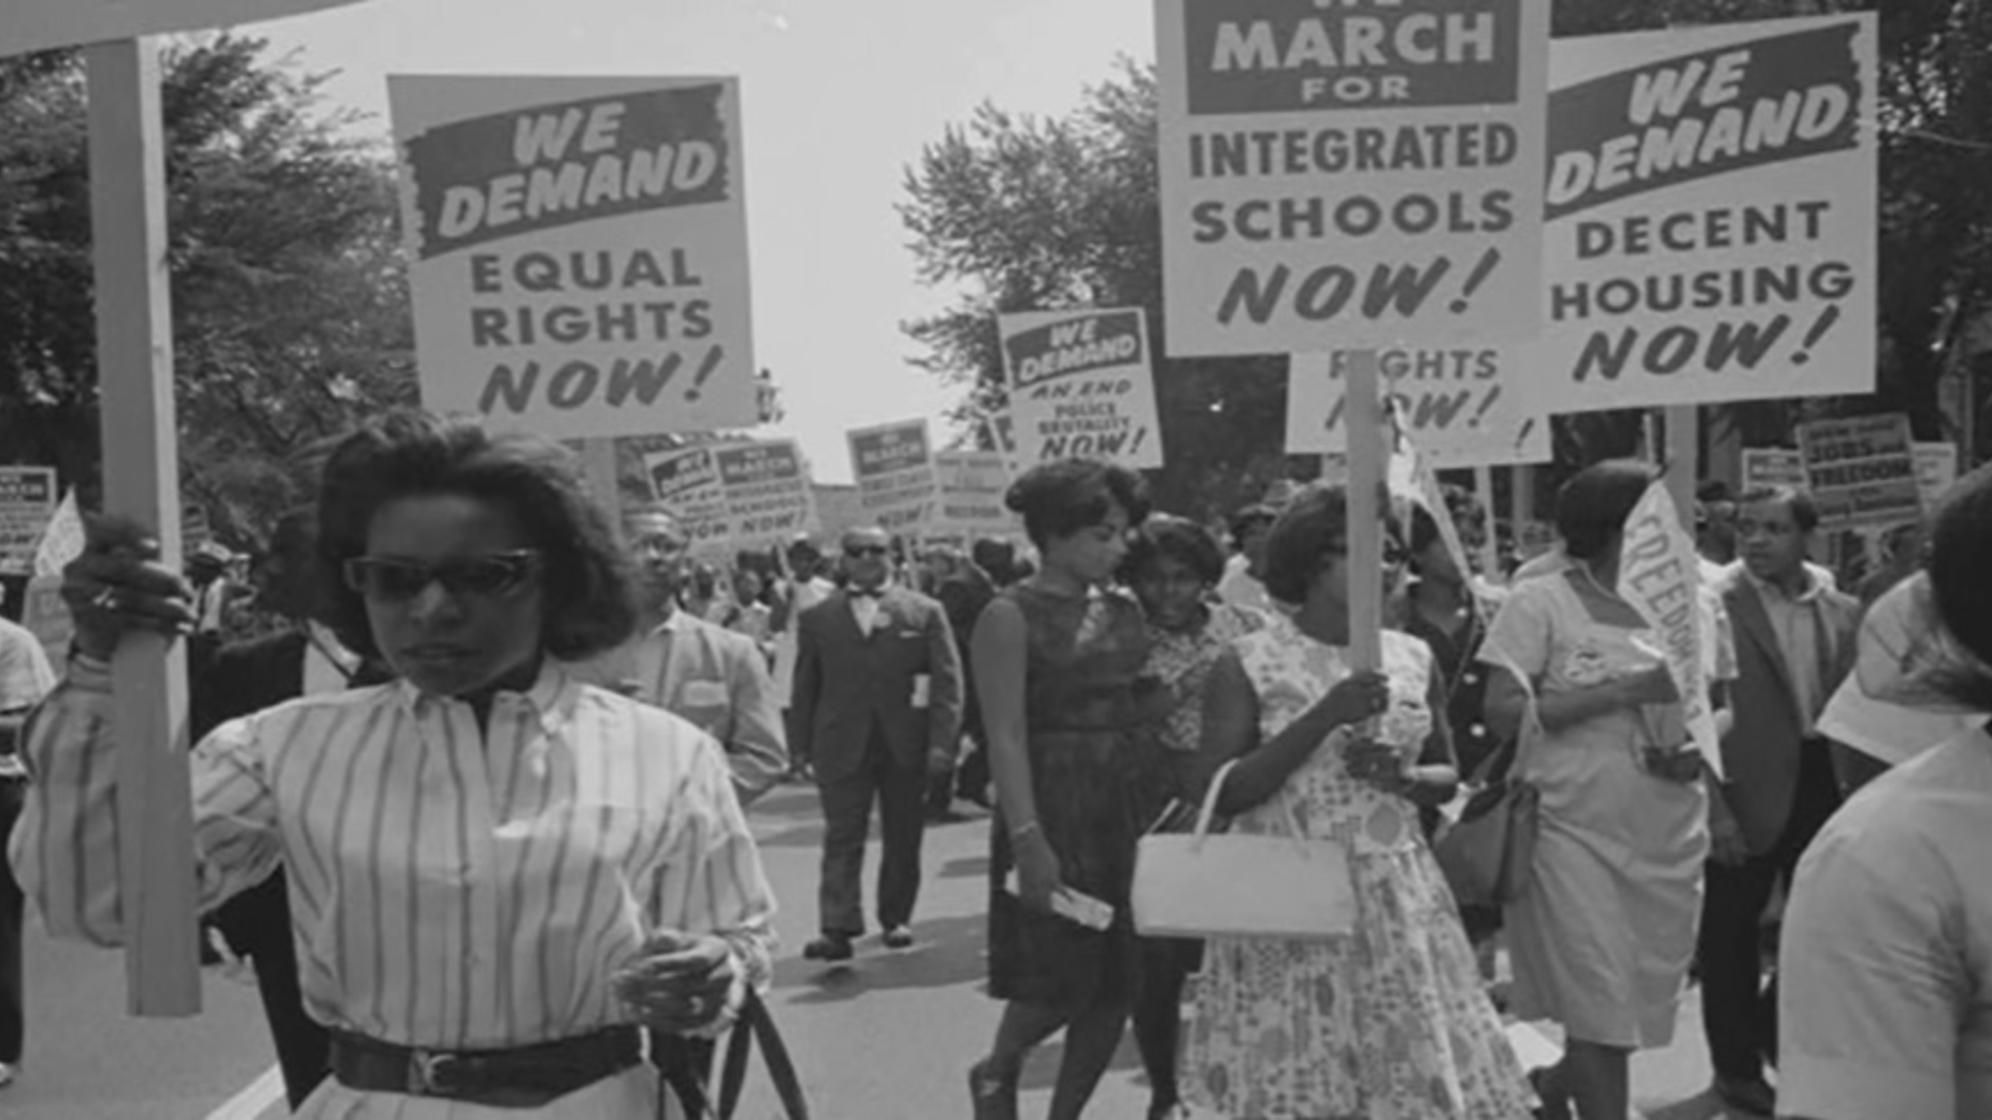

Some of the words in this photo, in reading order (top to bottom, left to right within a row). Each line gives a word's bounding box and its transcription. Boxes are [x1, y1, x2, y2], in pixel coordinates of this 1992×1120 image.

[1211, 12, 1494, 71] MARCH
[1302, 76, 1411, 102] FOR
[1628, 50, 1751, 125] WE
[513, 102, 627, 166] WE
[1189, 123, 1518, 178] INTEGRATED
[1546, 84, 1849, 206] DEMAND
[438, 141, 717, 238] DEMAND
[1191, 190, 1514, 243] SCHOOLS
[1576, 202, 1830, 259] DECENT
[470, 248, 703, 293] EQUAL
[1216, 246, 1501, 326] NOW!
[1551, 262, 1855, 321] HOUSING
[470, 299, 713, 347] RIGHTS
[1050, 319, 1098, 347] WE
[1573, 304, 1840, 382] NOW!
[478, 344, 724, 415] NOW!
[1019, 333, 1137, 382] DEMAND
[1329, 350, 1498, 380] RGHTS
[1031, 383, 1072, 399] AN
[1079, 379, 1132, 395] END
[1055, 402, 1115, 417] POLICE
[1038, 416, 1130, 435] BRUTALITY
[1040, 426, 1146, 460] NOW!
[1624, 514, 1692, 663] FREEDOM
